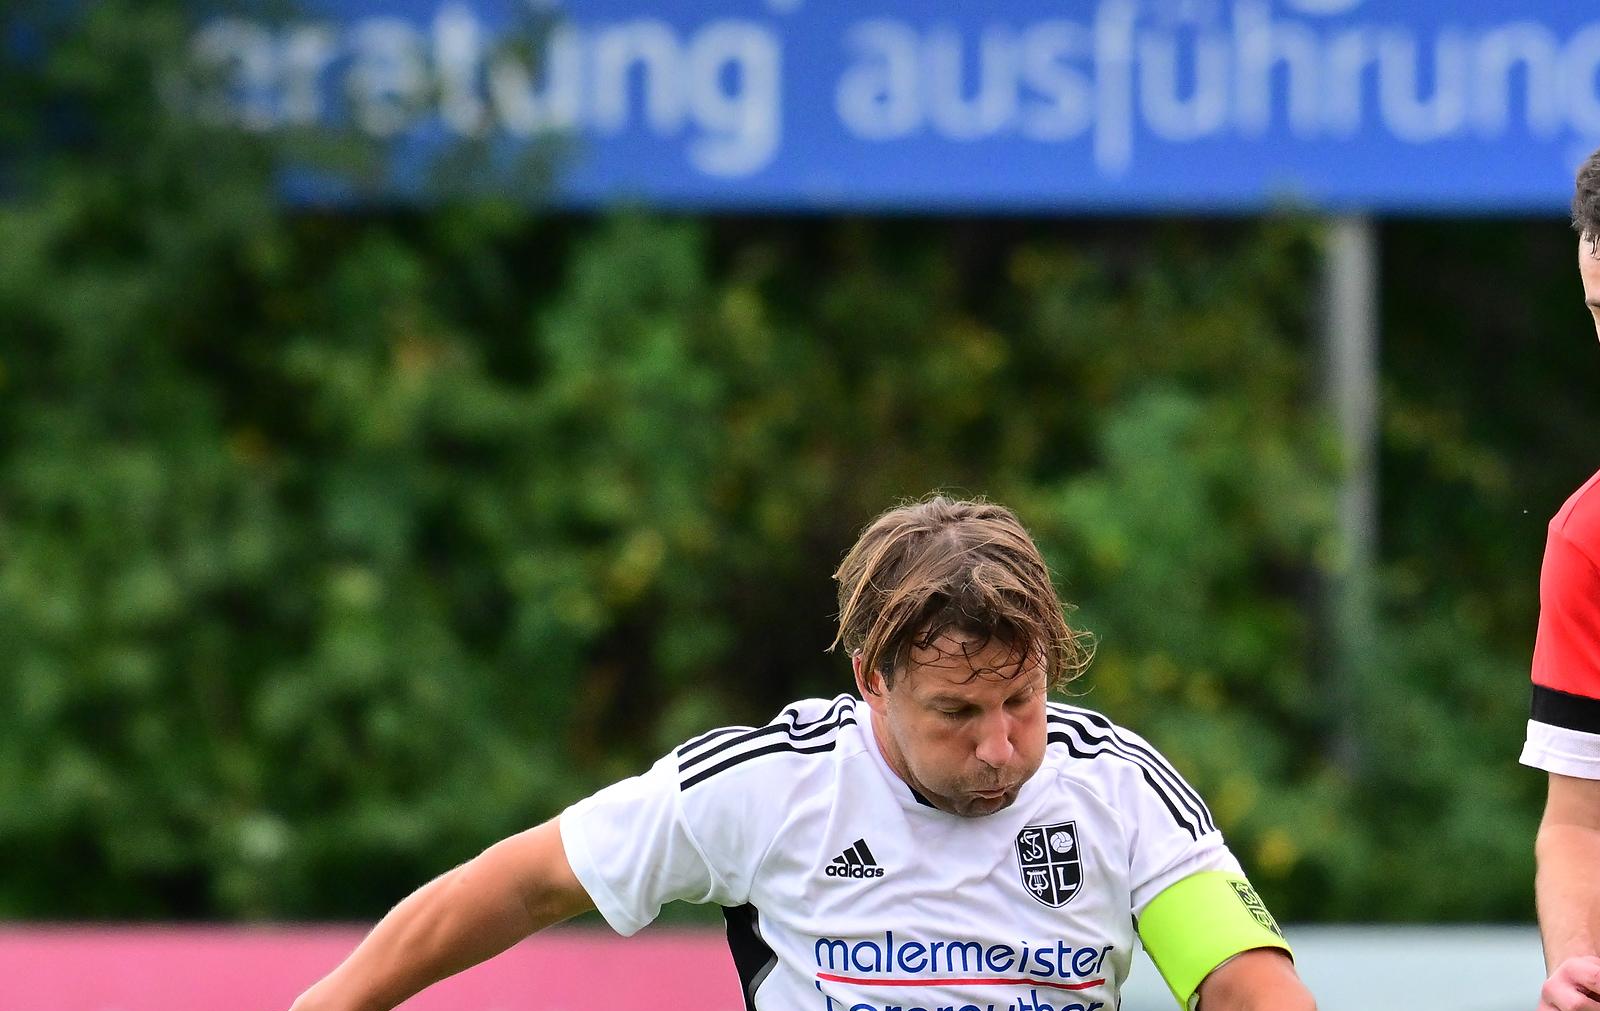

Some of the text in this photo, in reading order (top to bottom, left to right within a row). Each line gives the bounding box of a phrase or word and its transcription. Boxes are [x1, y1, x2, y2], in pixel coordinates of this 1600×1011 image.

[150, 5, 786, 178] eratung
[825, 863, 885, 879] adidas
[814, 931, 1115, 978] malermeister
